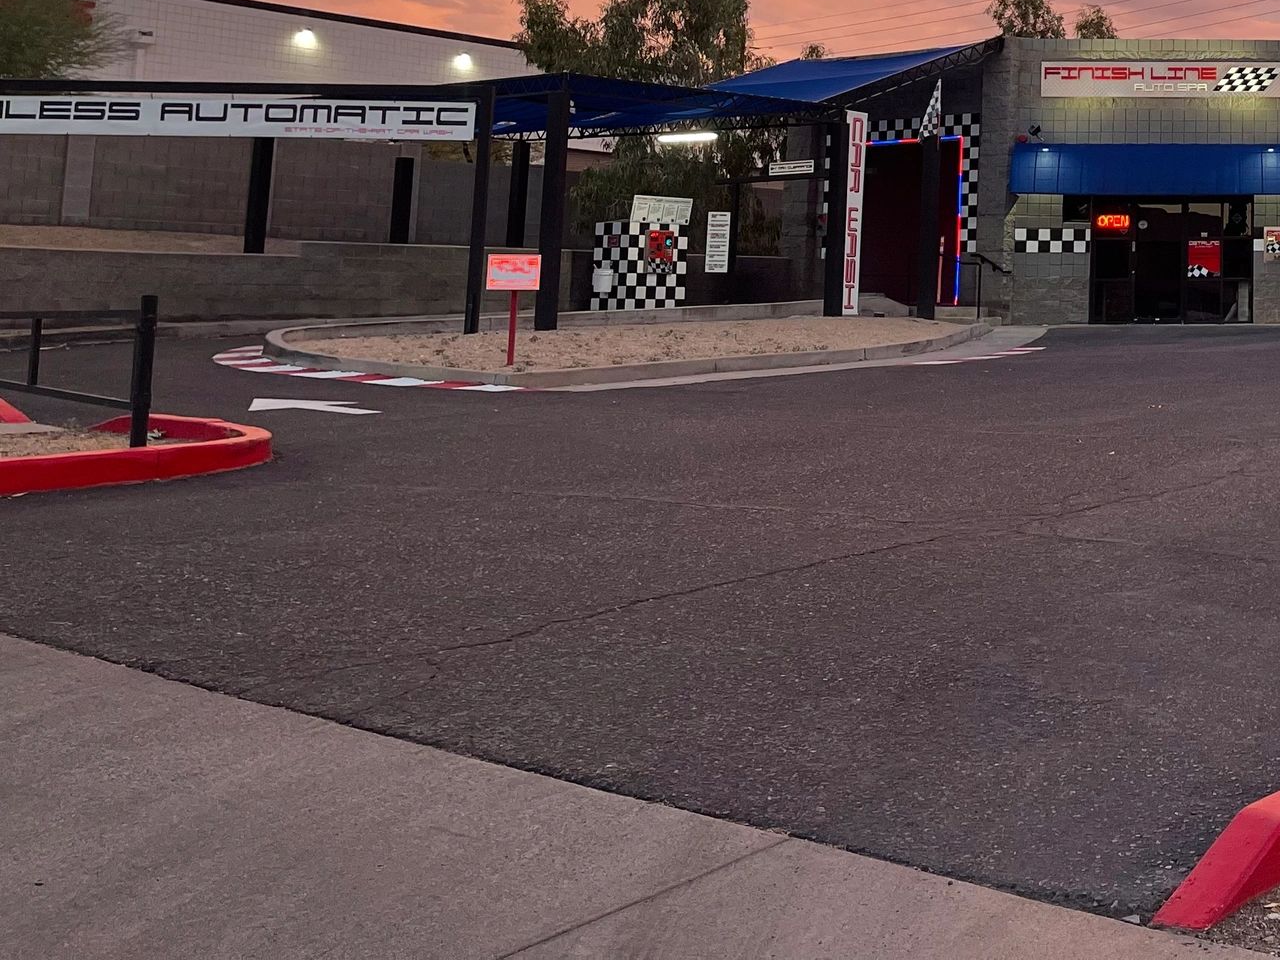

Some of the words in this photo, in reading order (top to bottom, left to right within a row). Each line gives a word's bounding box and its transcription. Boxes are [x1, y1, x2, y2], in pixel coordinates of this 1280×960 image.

[1044, 66, 1144, 80] FINISH
[1150, 66, 1217, 80] LINE
[1134, 83, 1174, 91] AUTO
[1177, 83, 1208, 91] SPA
[0, 100, 141, 121] LESS
[160, 103, 469, 126] AUTOMATIC
[850, 117, 863, 193] CAR
[1097, 214, 1130, 228] OPEN
[843, 206, 859, 309] WASH
